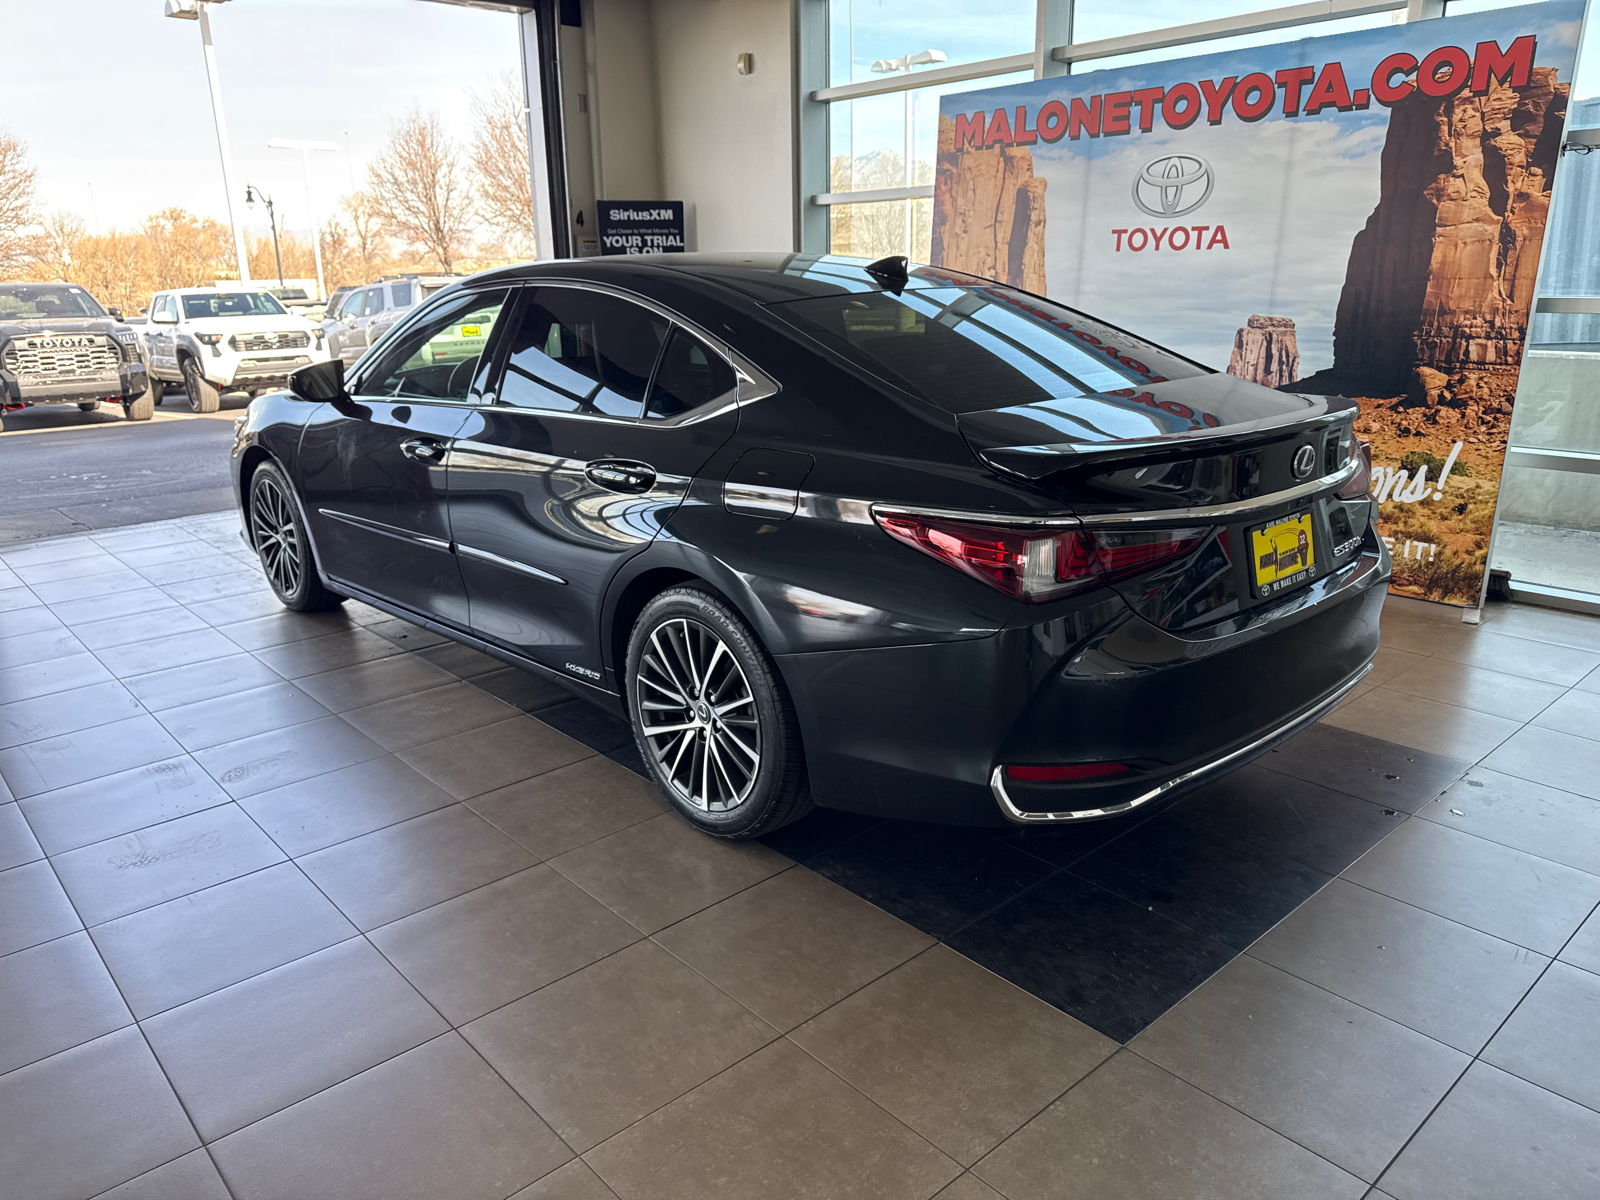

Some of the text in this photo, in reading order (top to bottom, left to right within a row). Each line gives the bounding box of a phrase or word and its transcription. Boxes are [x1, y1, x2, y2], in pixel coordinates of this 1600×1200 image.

[954, 34, 1537, 153] MALONETOYOTA.COM
[609, 209, 674, 221] SiriusXM
[603, 235, 642, 248] YOUR
[644, 235, 684, 247] TRIAL
[1111, 225, 1230, 252] TOYOTA
[33, 337, 90, 349] TOYOTA
[1299, 534, 1306, 545] 32
[1403, 540, 1437, 562] IT!
[1272, 581, 1280, 591] WE
[1280, 577, 1292, 589] MAKE
[701, 604, 730, 628] ROAD
[565, 662, 601, 680] HYBRID
